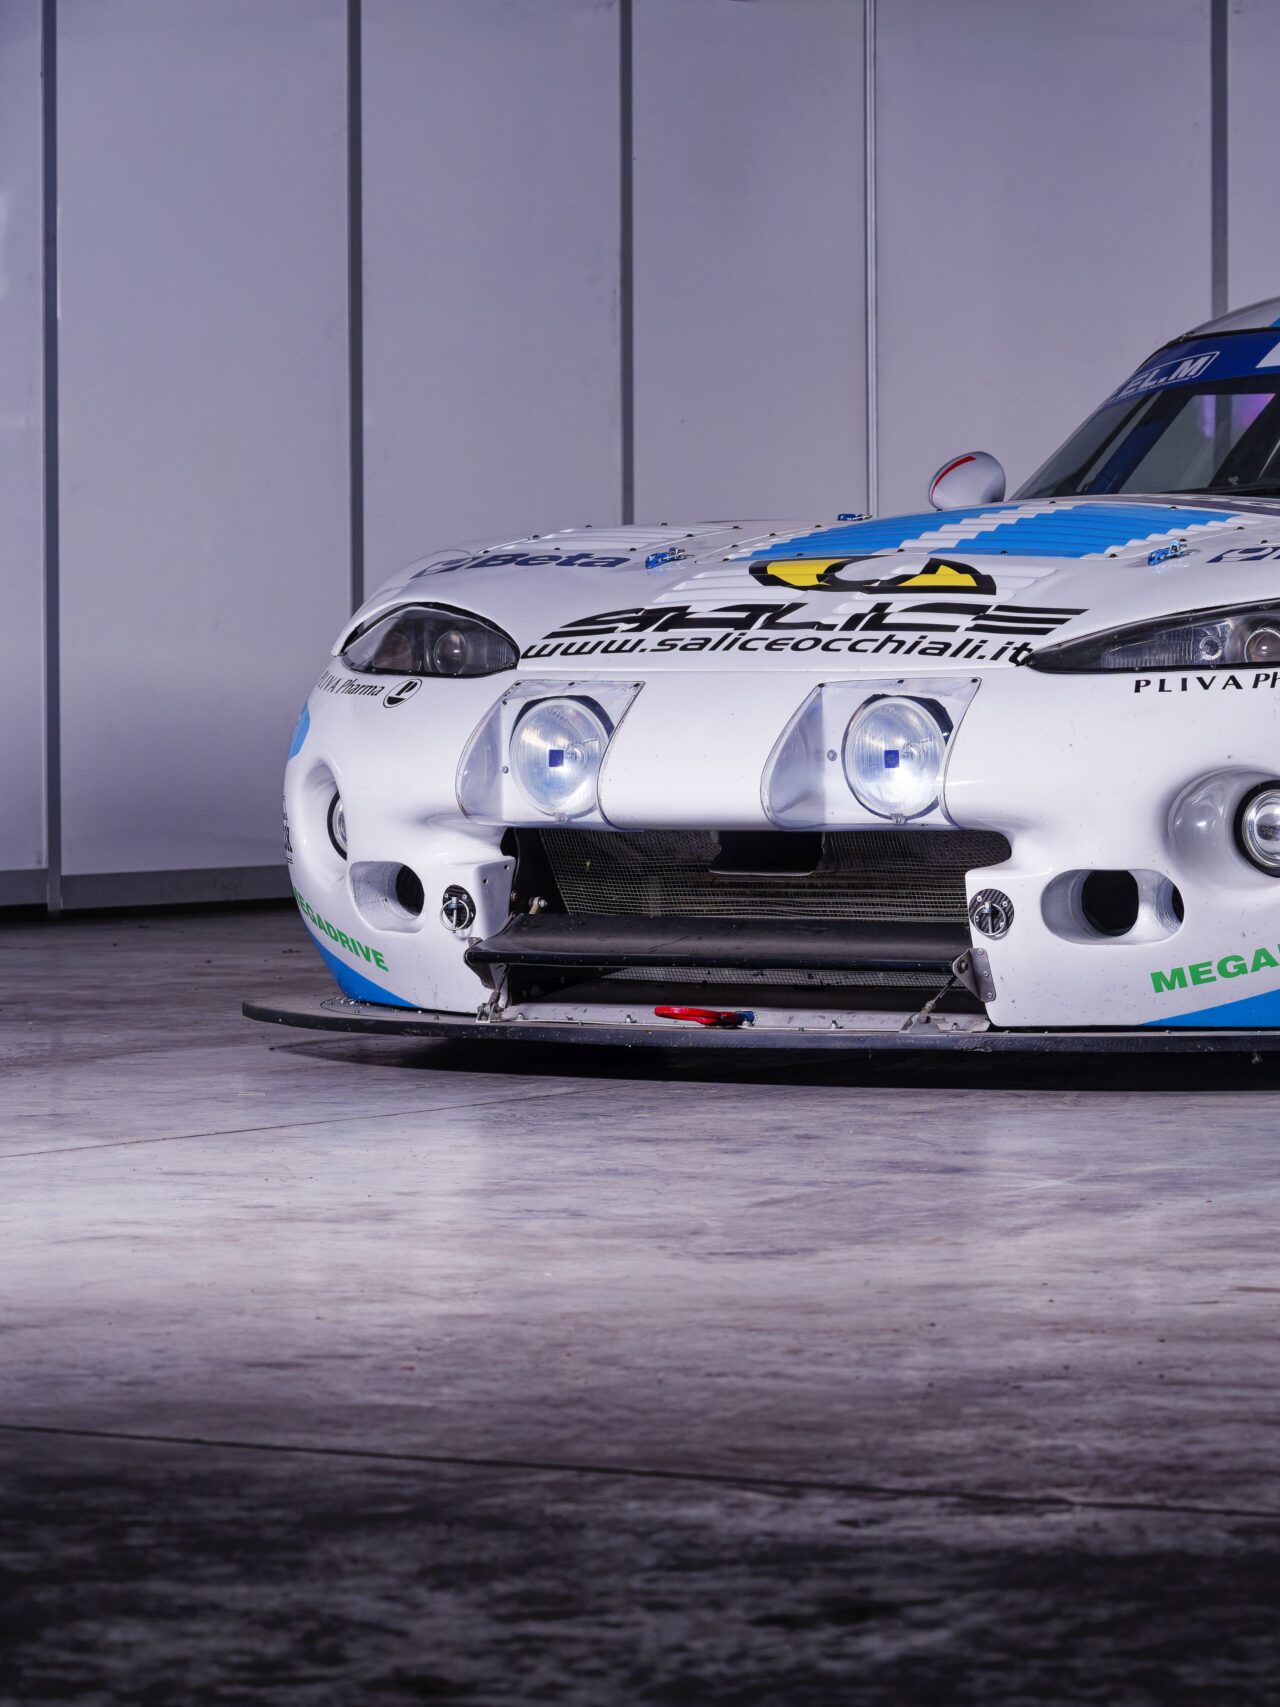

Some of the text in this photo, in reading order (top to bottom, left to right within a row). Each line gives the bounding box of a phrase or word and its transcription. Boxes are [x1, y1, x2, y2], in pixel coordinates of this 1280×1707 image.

[466, 552, 633, 568] Beta
[540, 601, 1090, 640] SALICE
[521, 633, 1034, 667] www.saliceocchiali.it
[340, 678, 385, 696] Pharma
[1133, 674, 1244, 694] PLIVA
